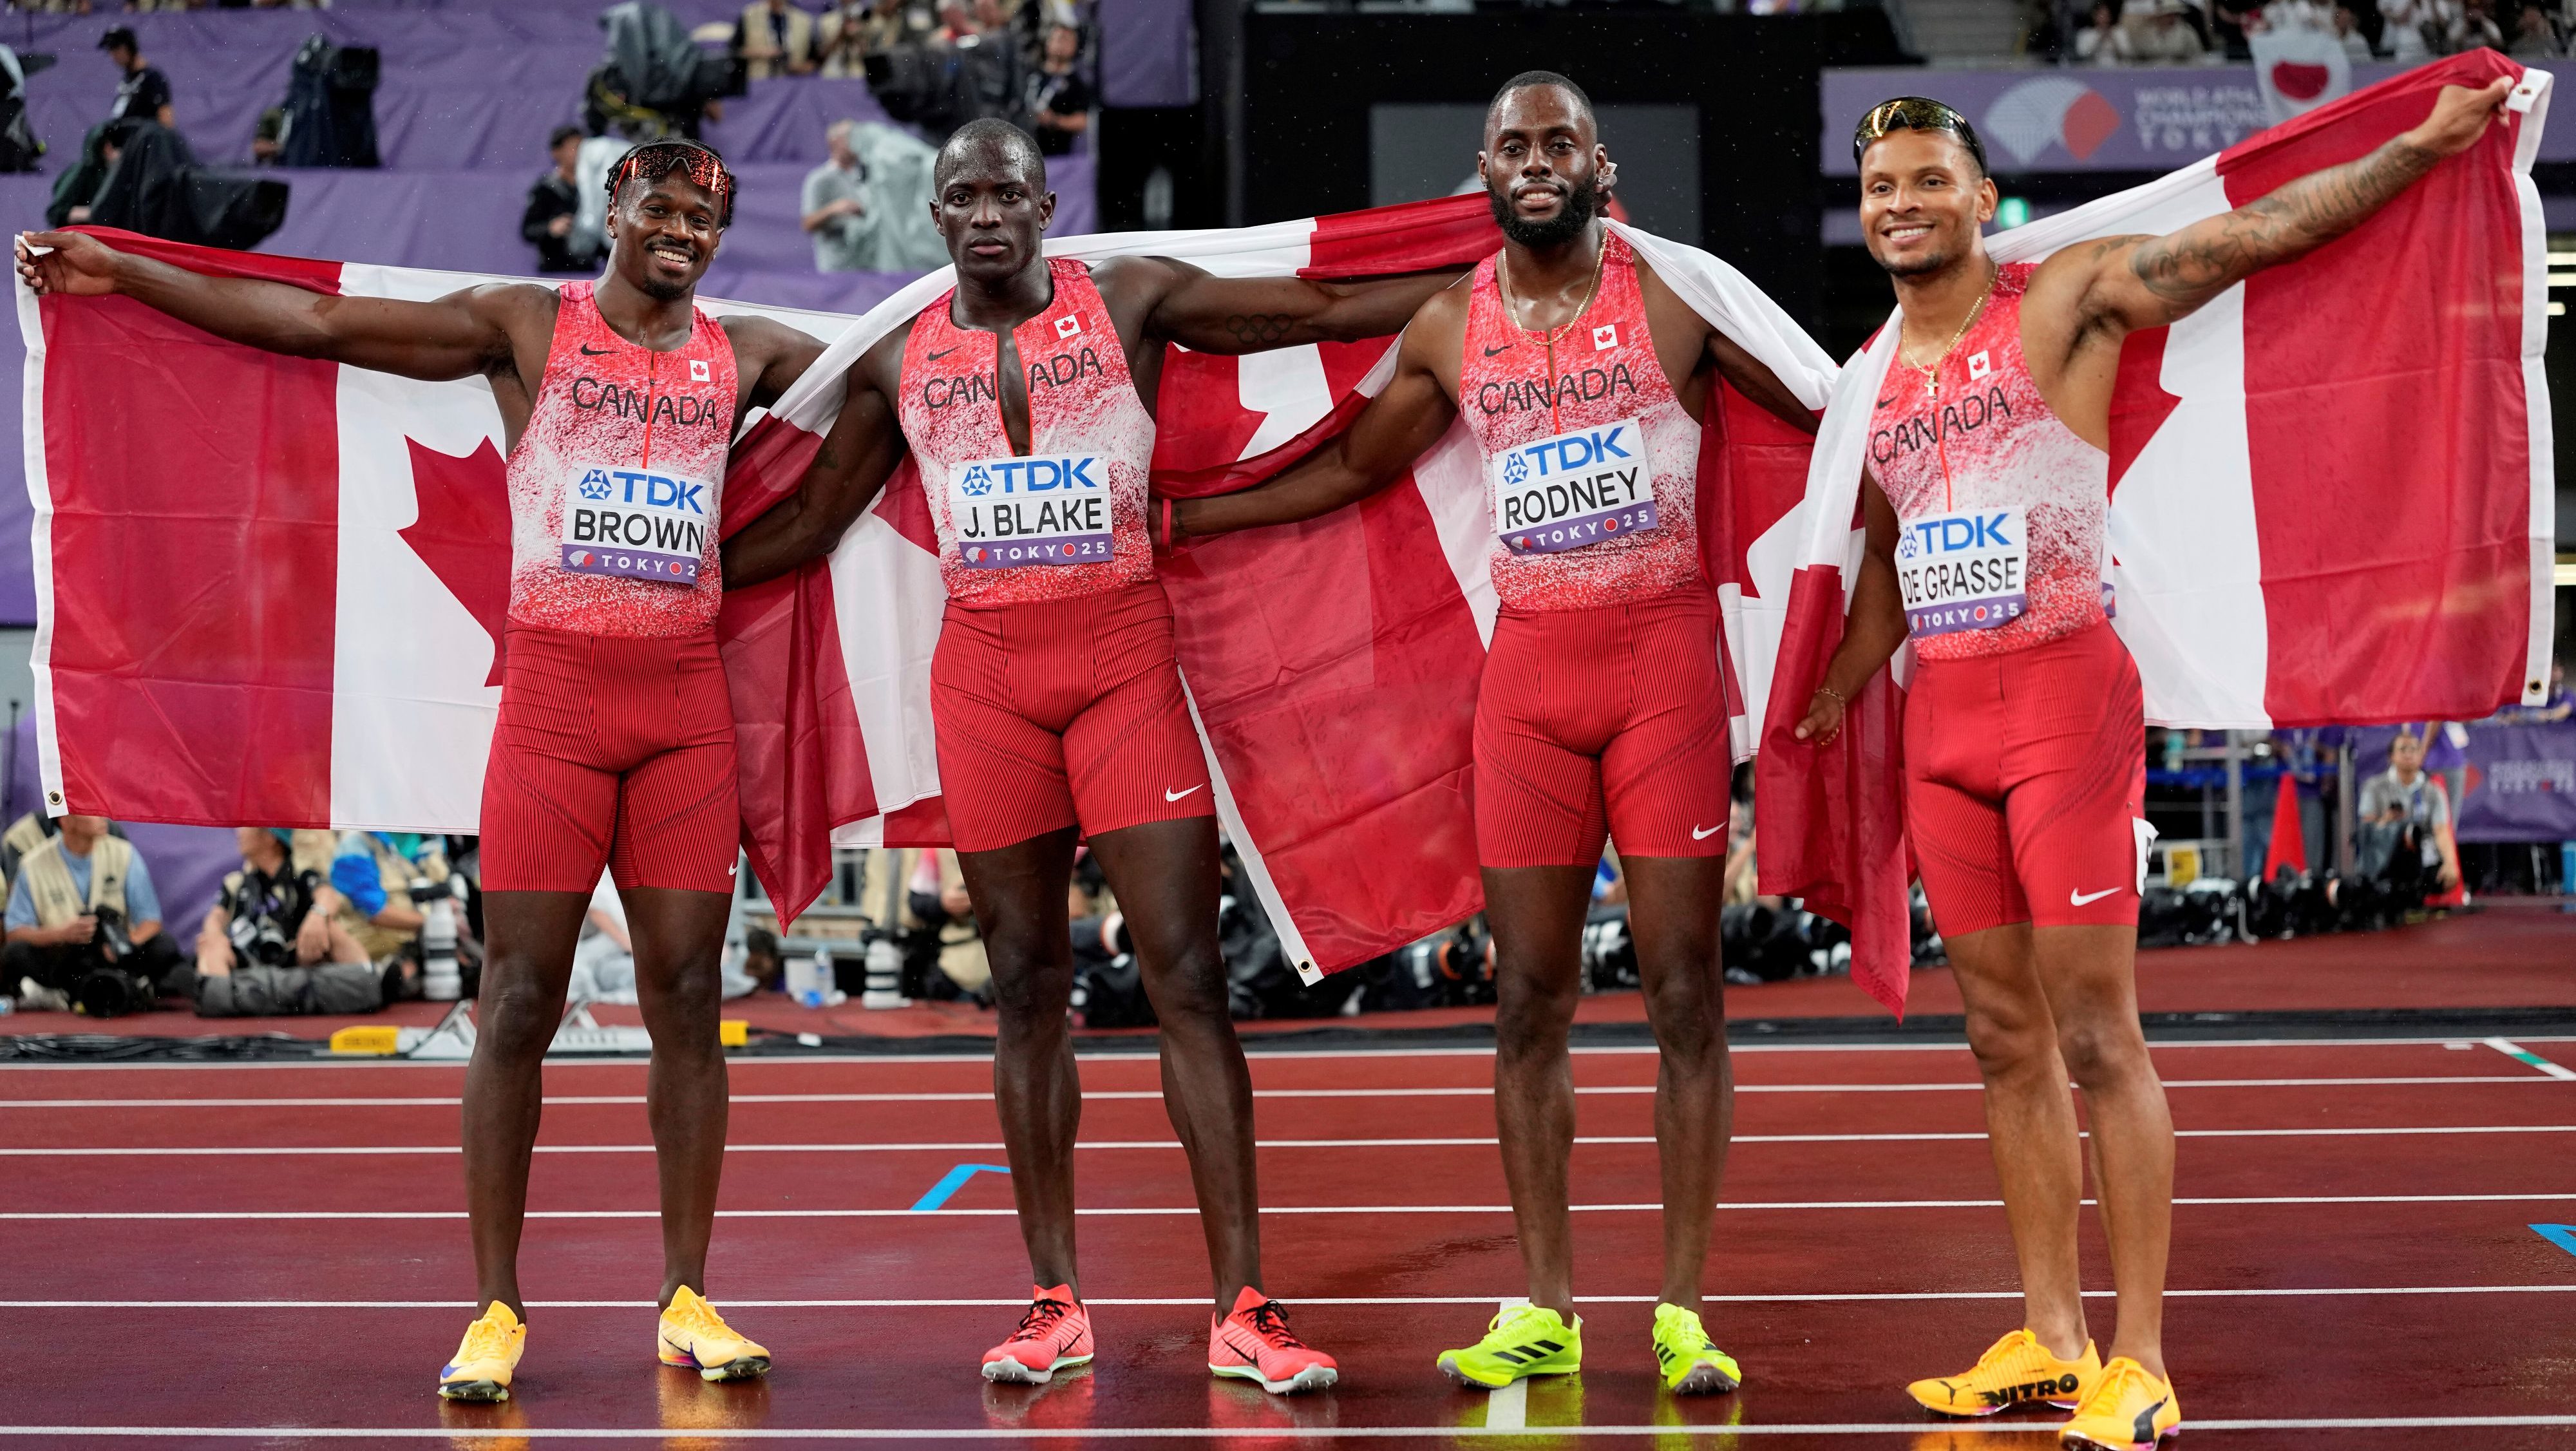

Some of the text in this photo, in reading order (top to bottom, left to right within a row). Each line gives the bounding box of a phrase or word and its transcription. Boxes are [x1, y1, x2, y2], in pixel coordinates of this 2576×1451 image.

[2137, 126, 2239, 151] TOKY
[573, 377, 717, 430] CANADA
[1480, 363, 1636, 415] CANADA
[1873, 386, 2011, 464] CANADA
[1526, 426, 1631, 476] TDK
[612, 471, 704, 515] TDK
[991, 457, 1097, 493] TDK
[1505, 466, 1638, 529] RODNEY
[573, 509, 704, 555] BROWN
[963, 498, 1103, 538] J. BLAKE
[1916, 513, 2013, 554] TDK
[687, 564, 696, 577] 2
[1902, 557, 2019, 604] DE GRASSE
[1976, 1373, 2079, 1406] NITRO
